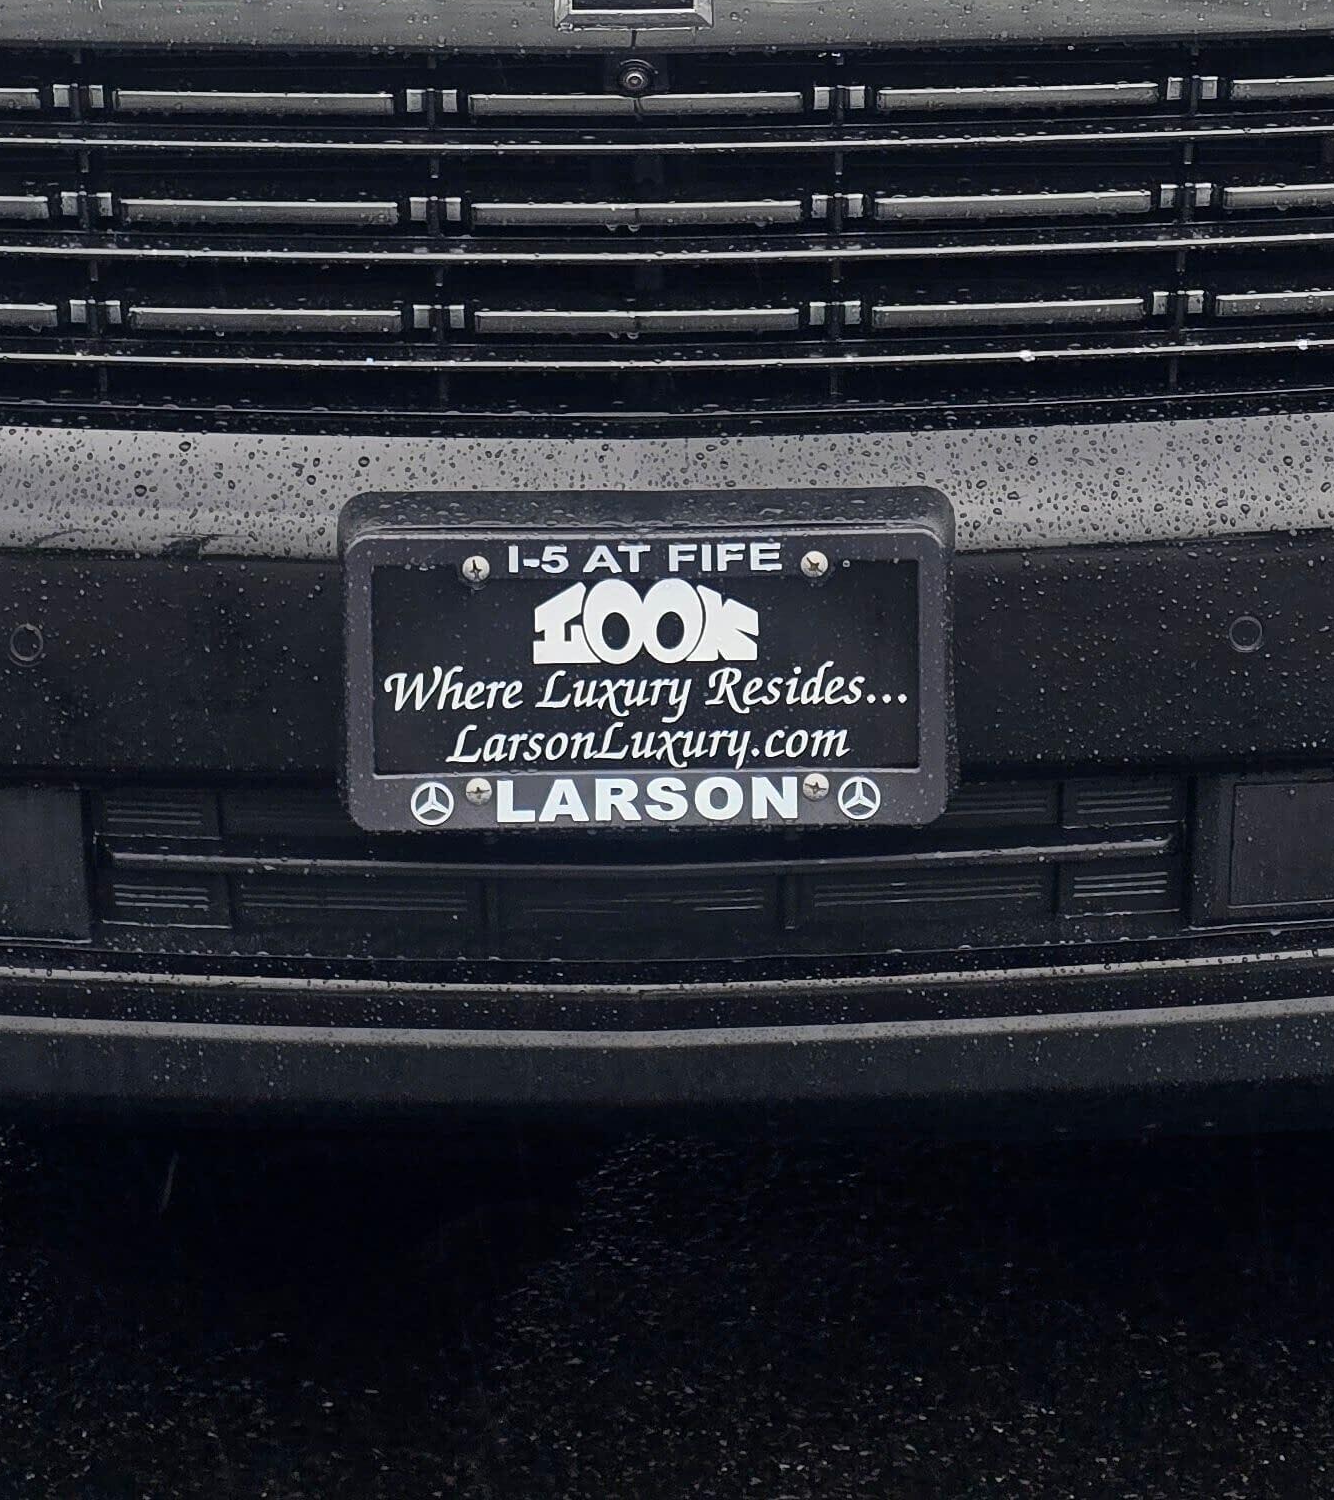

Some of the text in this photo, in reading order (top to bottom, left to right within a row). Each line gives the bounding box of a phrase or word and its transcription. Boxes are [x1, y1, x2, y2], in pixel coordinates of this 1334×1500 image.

[507, 542, 783, 574] I-5 AT FIFE
[384, 660, 908, 723] Where Luxury Resides...
[445, 722, 850, 769] LarsonLuxury.com
[496, 776, 798, 823] LARSON
